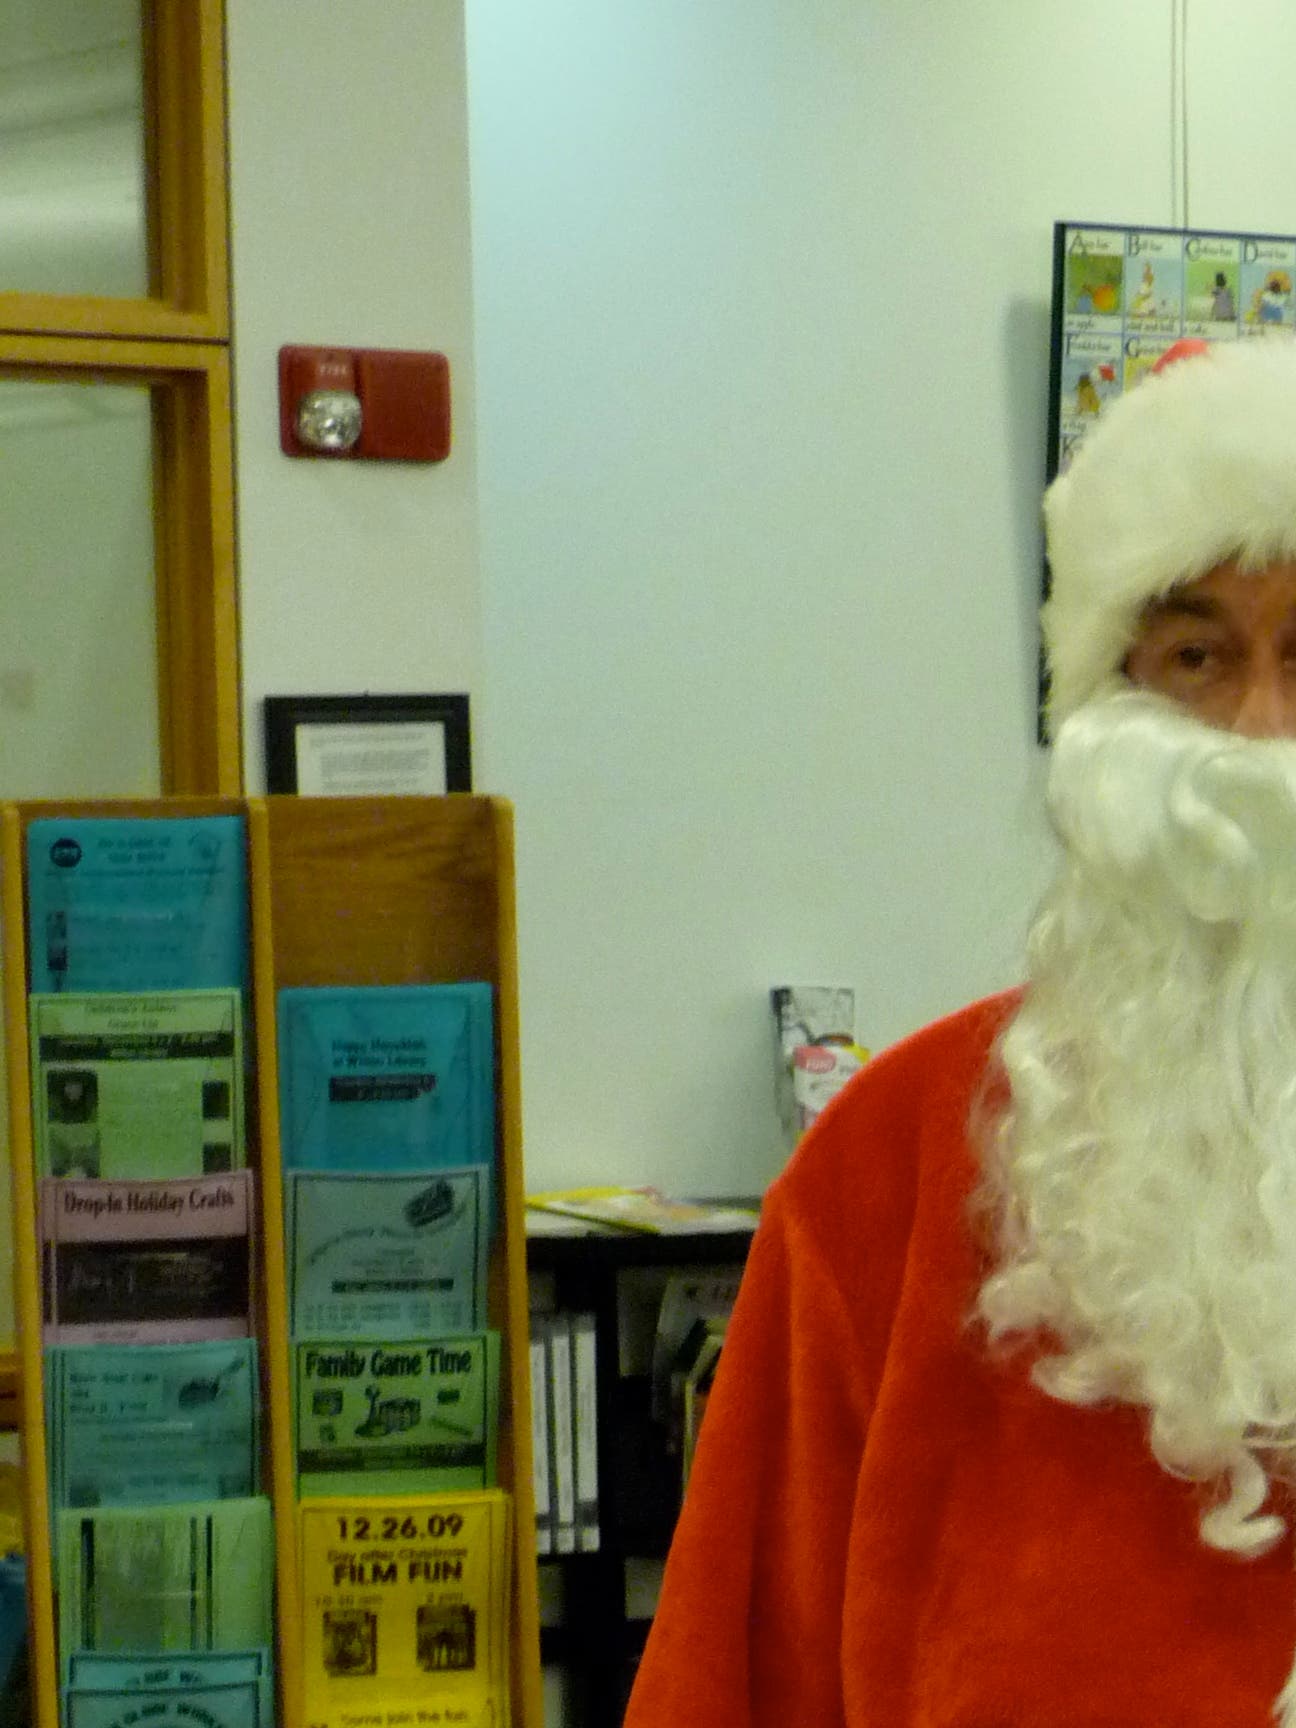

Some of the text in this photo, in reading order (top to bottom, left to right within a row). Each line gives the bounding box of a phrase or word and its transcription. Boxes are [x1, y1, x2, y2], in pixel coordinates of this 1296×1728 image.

[126, 1190, 184, 1217] Holiday
[189, 1187, 235, 1213] Crafts
[305, 1347, 471, 1379] Family Game Time
[336, 1513, 463, 1541] 12.26.09
[333, 1559, 462, 1586] FILM FUN
